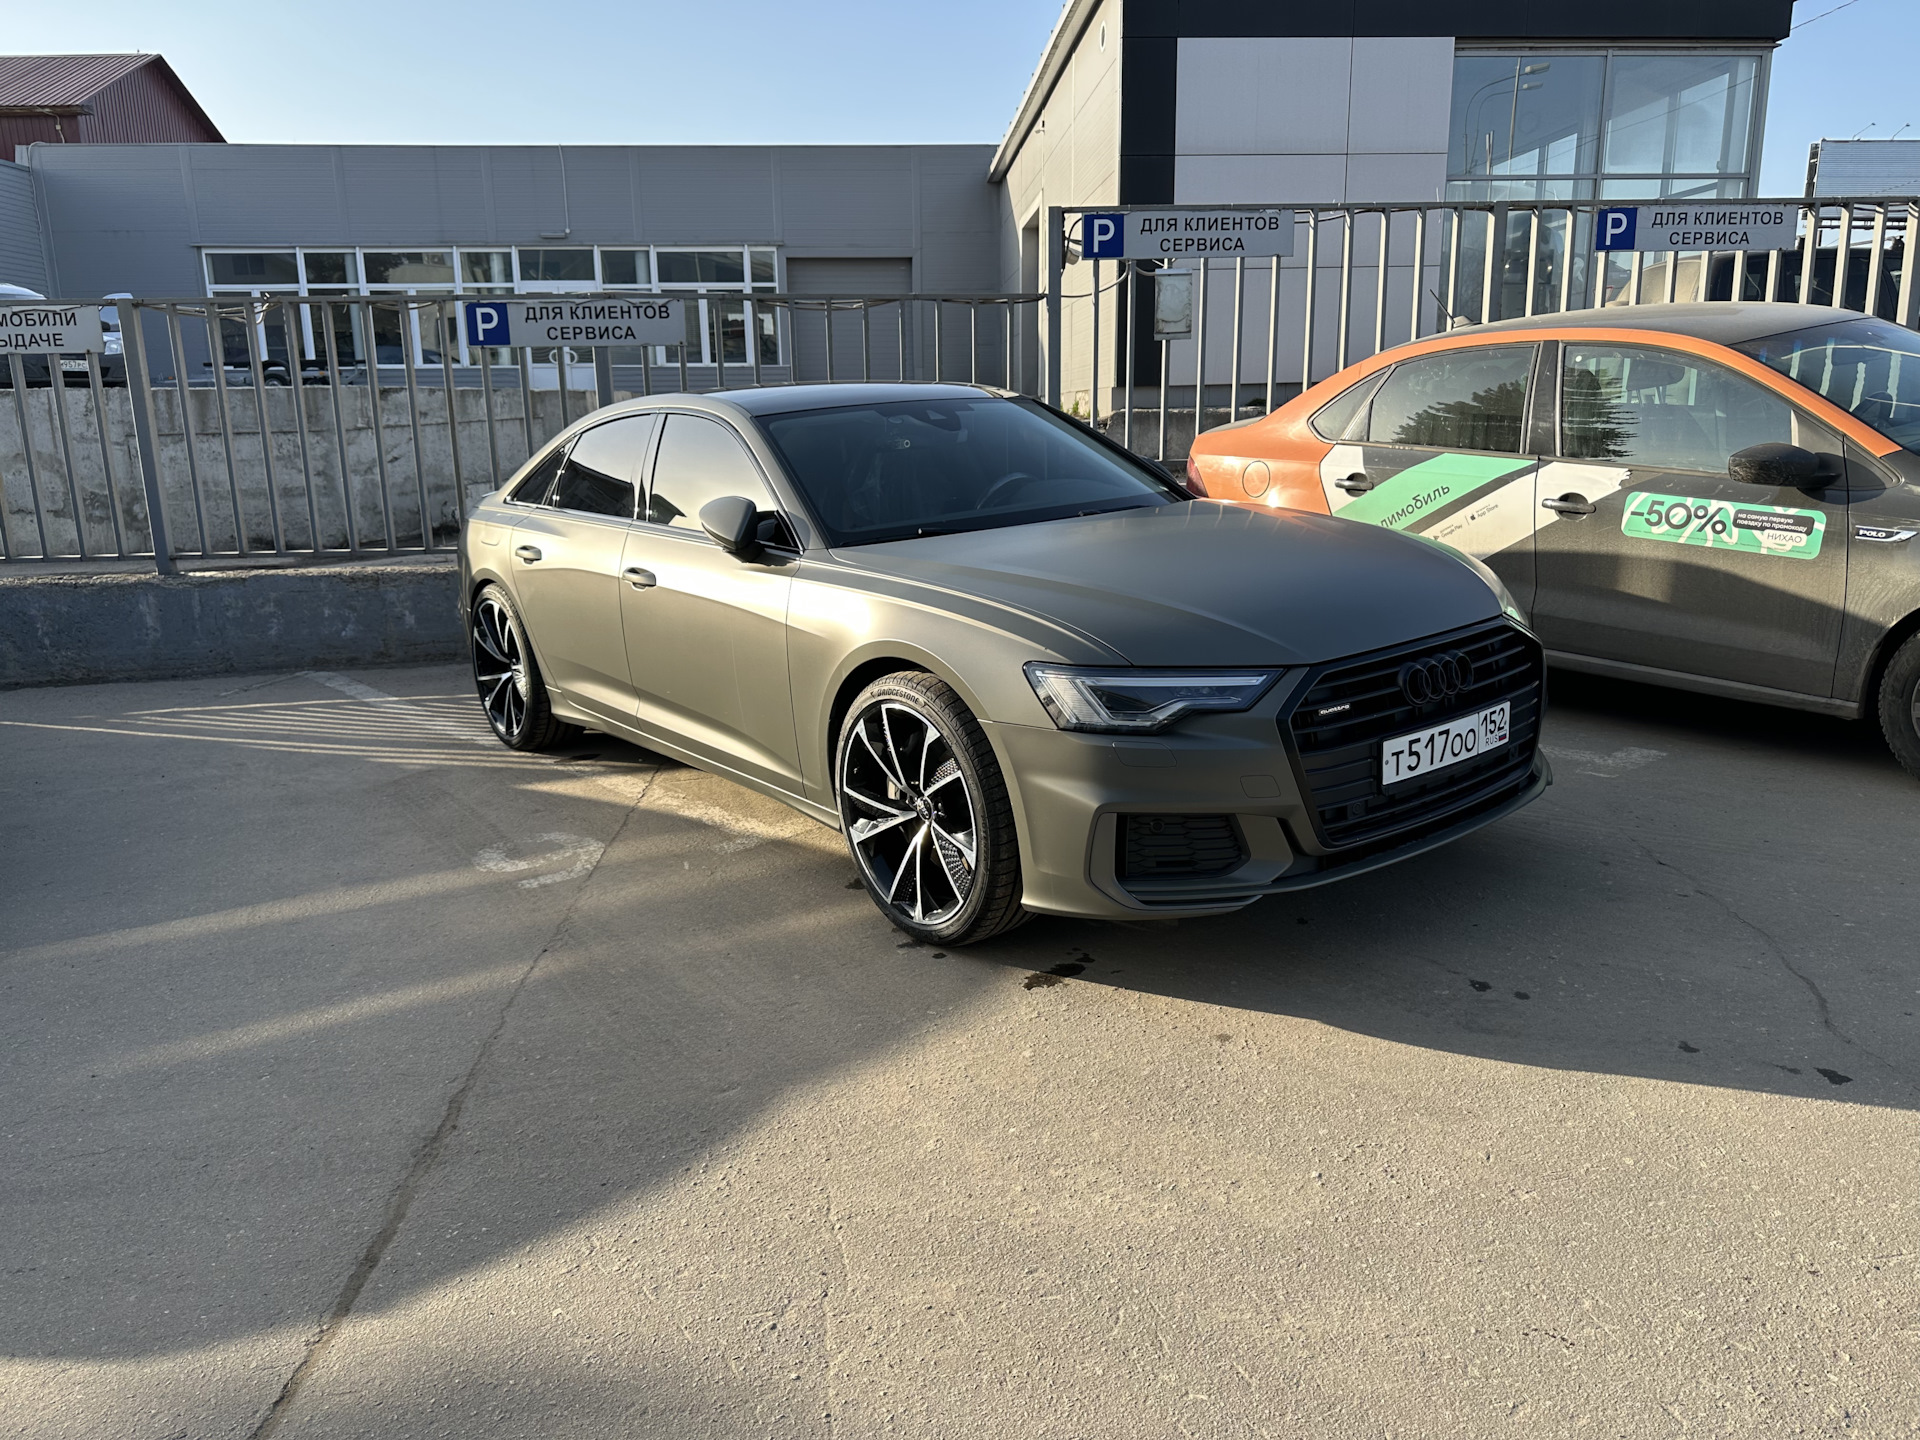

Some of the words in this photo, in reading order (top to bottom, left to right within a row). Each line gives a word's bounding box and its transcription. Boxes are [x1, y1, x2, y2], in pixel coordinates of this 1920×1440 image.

[1140, 218, 1178, 235] ДЛЯ
[1184, 216, 1279, 232] КЛИЕНТОВ
[1651, 212, 1688, 228] ДЛЯ
[1693, 211, 1784, 226] КЛИЕНТОВ
[1093, 218, 1115, 253] P
[1605, 212, 1628, 246] P
[1160, 237, 1245, 252] СЕРВИСА
[1669, 231, 1750, 246] СЕРВИСА
[525, 306, 563, 323] ДЛЯ
[570, 305, 670, 321] КЛИЕНТОВ
[475, 307, 499, 342] P
[547, 325, 637, 341] СЕРВИСА
[1630, 499, 1727, 535] -50%
[1767, 532, 1803, 543] НИХАО
[1858, 528, 1887, 538] POLO
[876, 688, 920, 705] BRIDGESTONE
[1480, 707, 1505, 737] 152
[1485, 734, 1498, 747] RUS
